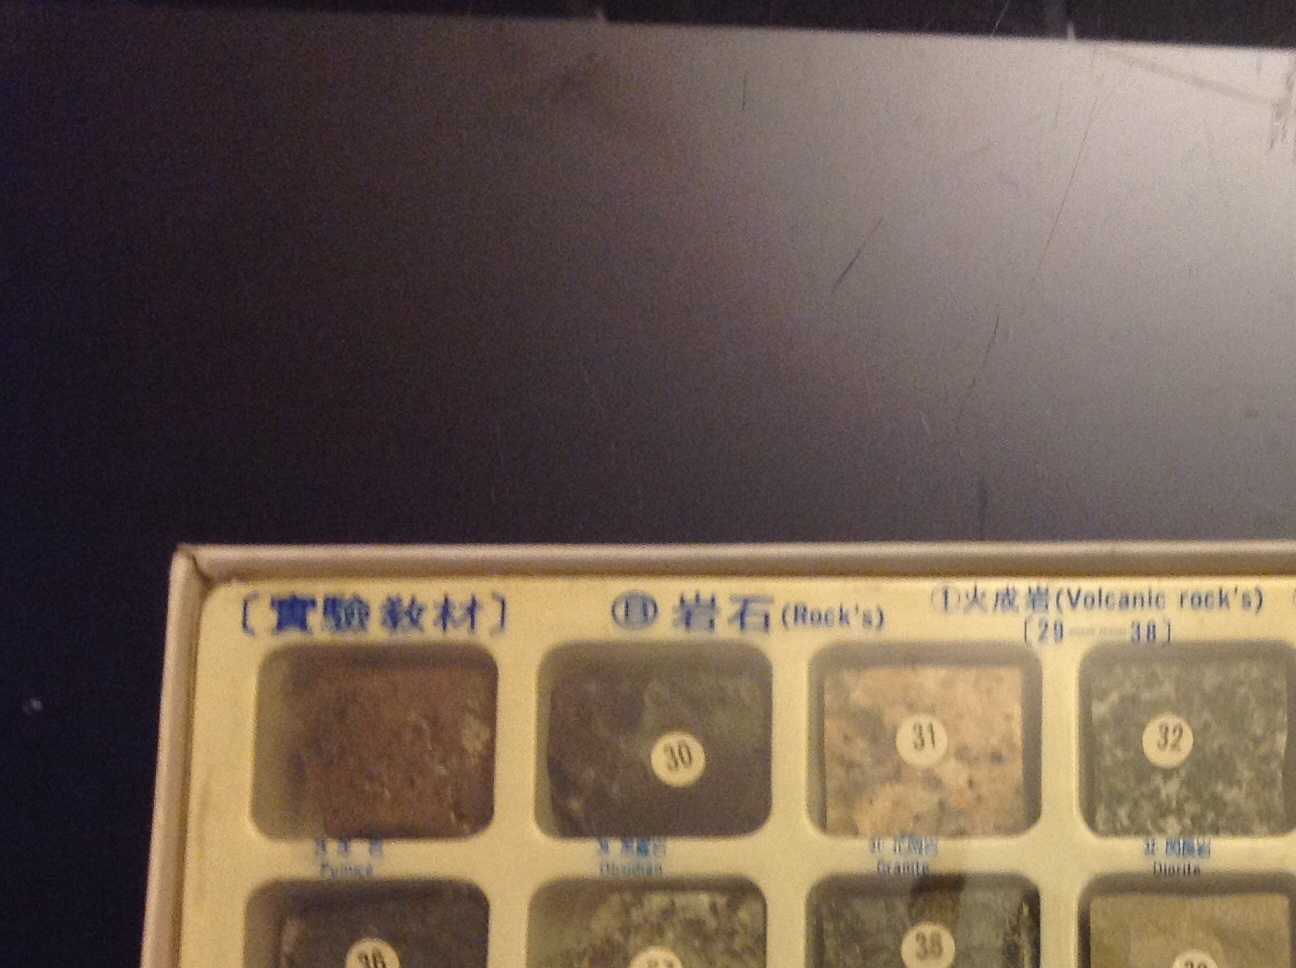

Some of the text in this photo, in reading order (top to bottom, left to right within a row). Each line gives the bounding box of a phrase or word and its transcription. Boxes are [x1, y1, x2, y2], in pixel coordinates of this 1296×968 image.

[1179, 587, 1265, 613] rock's)
[781, 601, 886, 631] (Rock's)
[913, 722, 935, 751] 31
[1157, 722, 1184, 752] 32
[664, 740, 692, 771] 30
